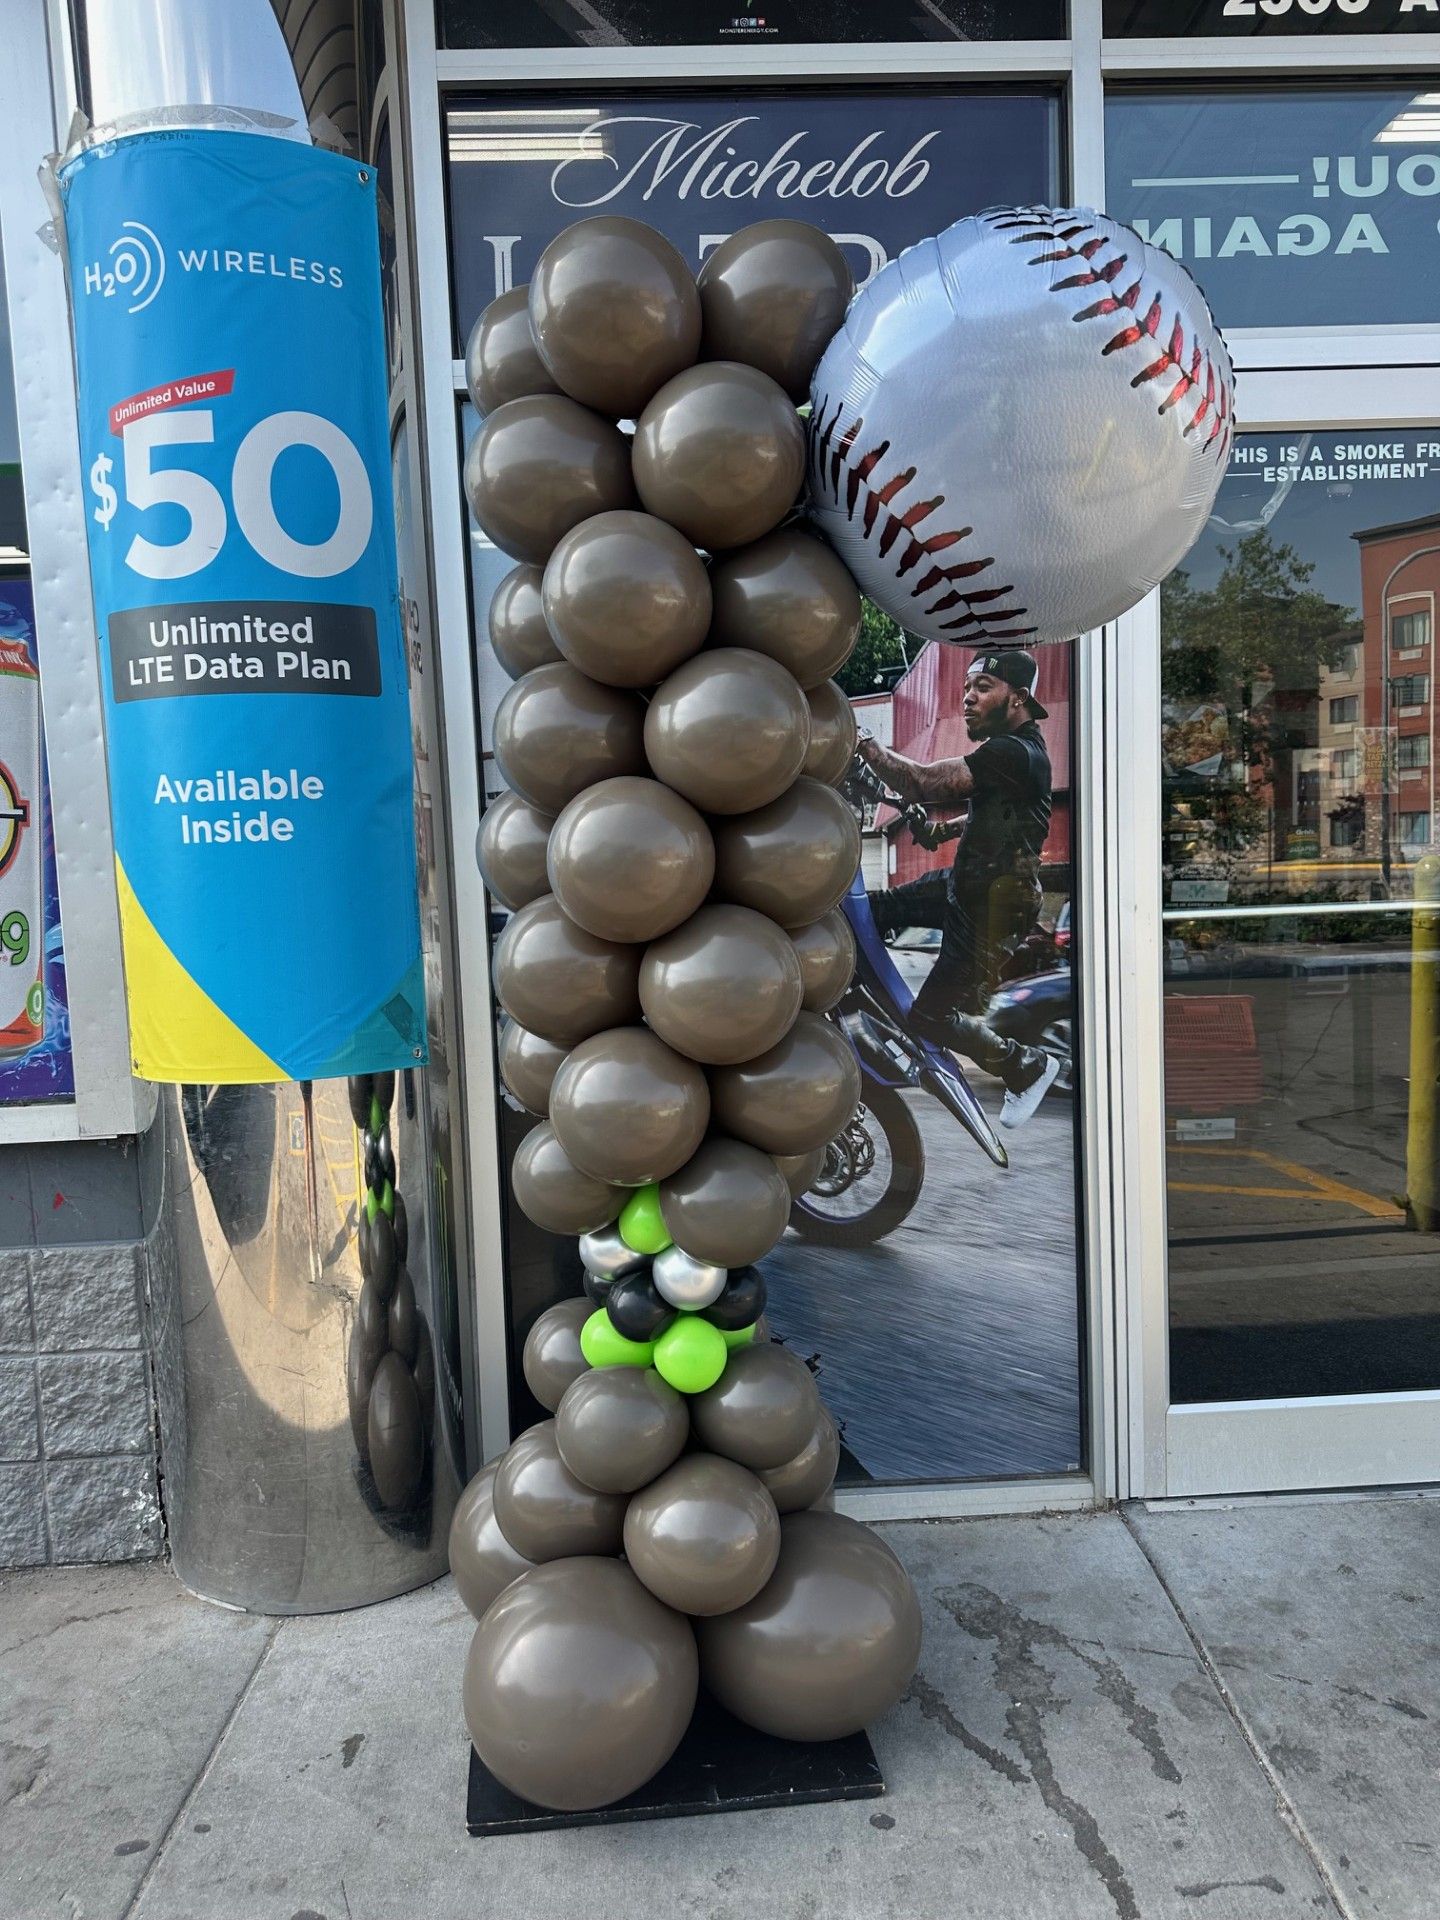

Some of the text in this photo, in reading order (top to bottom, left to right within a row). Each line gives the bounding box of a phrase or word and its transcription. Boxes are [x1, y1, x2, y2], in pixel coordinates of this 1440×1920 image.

[551, 116, 942, 208] Michelob
[178, 250, 343, 288] WIRELESS
[115, 380, 216, 423] Unlimited Value
[1231, 447, 1268, 463] HIS
[1280, 446, 1299, 462] IS
[1310, 446, 1323, 461] A
[1334, 444, 1404, 460] SMOKE
[1263, 462, 1428, 482] ESTABLISHMENT
[90, 410, 374, 580] $50
[149, 615, 314, 648] Unlimited
[128, 651, 351, 686] LTE Data Plan
[154, 769, 324, 804] Available
[181, 811, 294, 844] Inside
